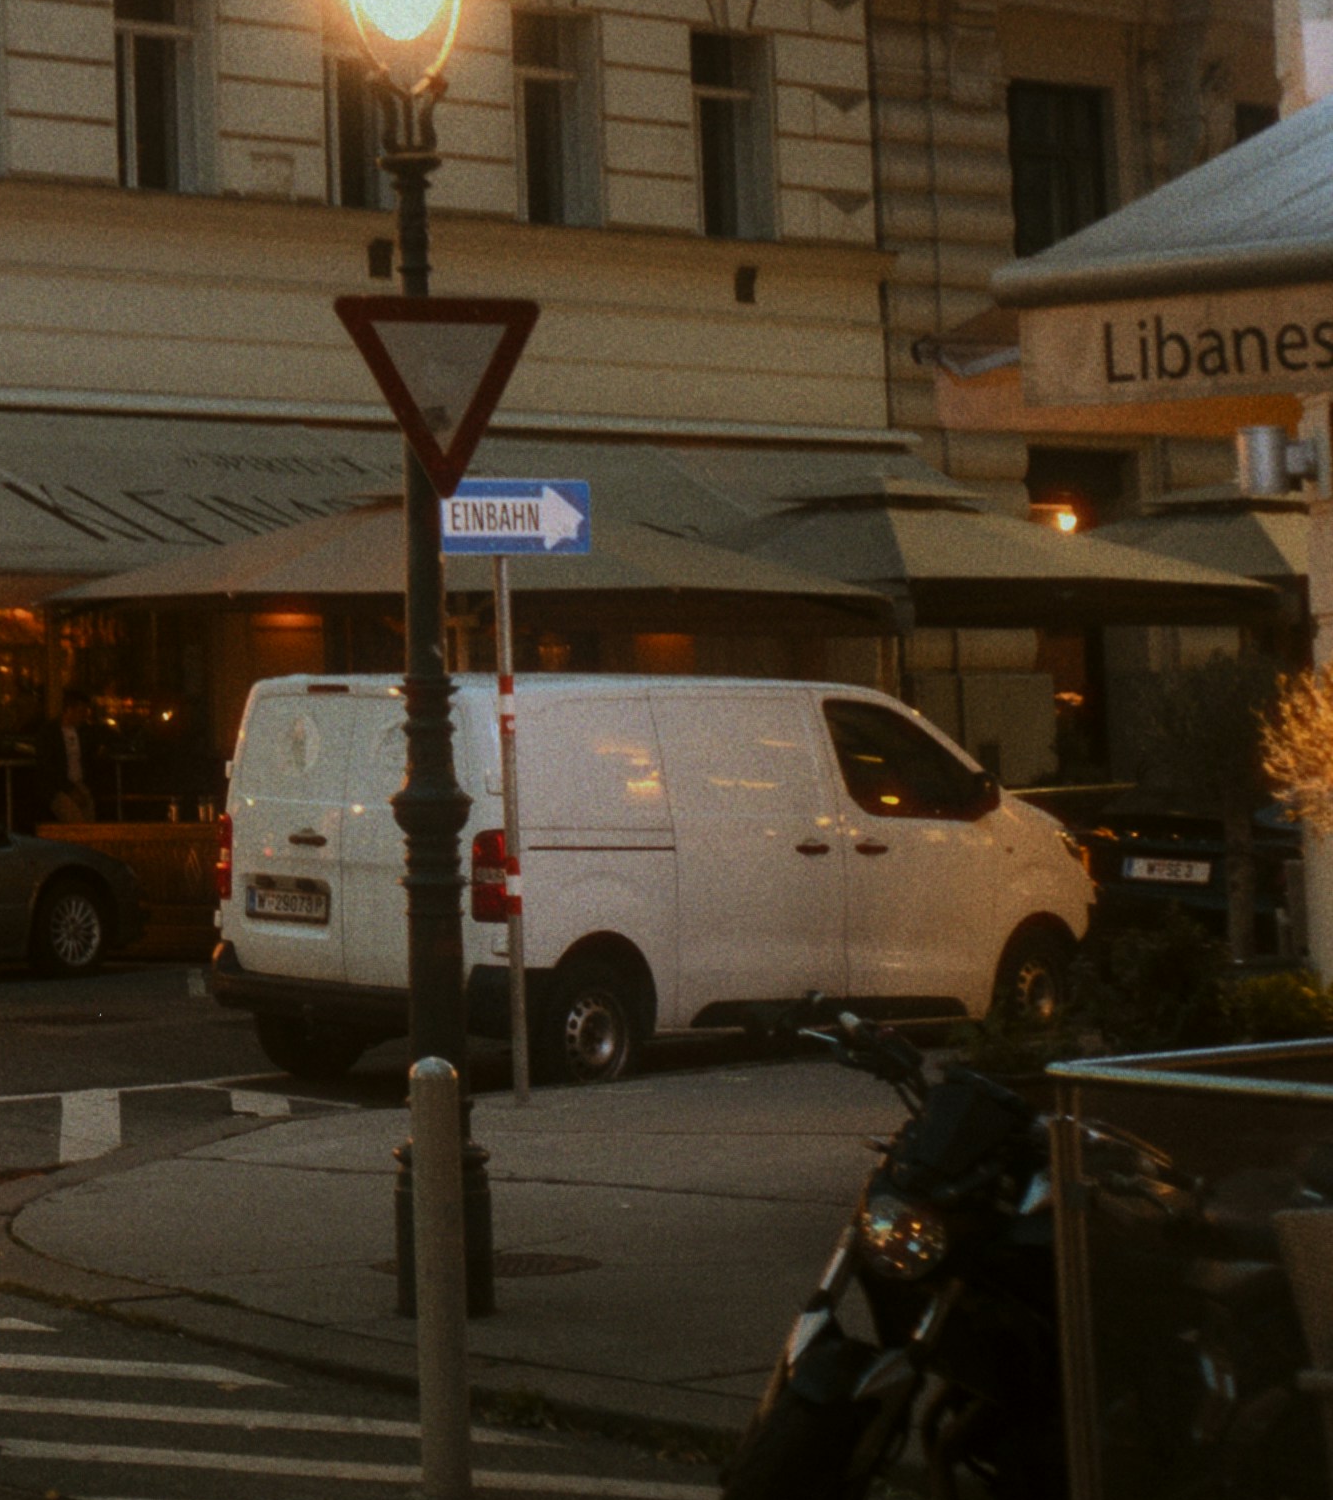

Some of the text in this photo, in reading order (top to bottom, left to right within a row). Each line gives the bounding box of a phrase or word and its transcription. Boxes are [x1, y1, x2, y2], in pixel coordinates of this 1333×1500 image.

[1103, 315, 1333, 384] Libanes
[2, 482, 333, 546] KLEIN
[450, 501, 540, 532] EINBAHN
